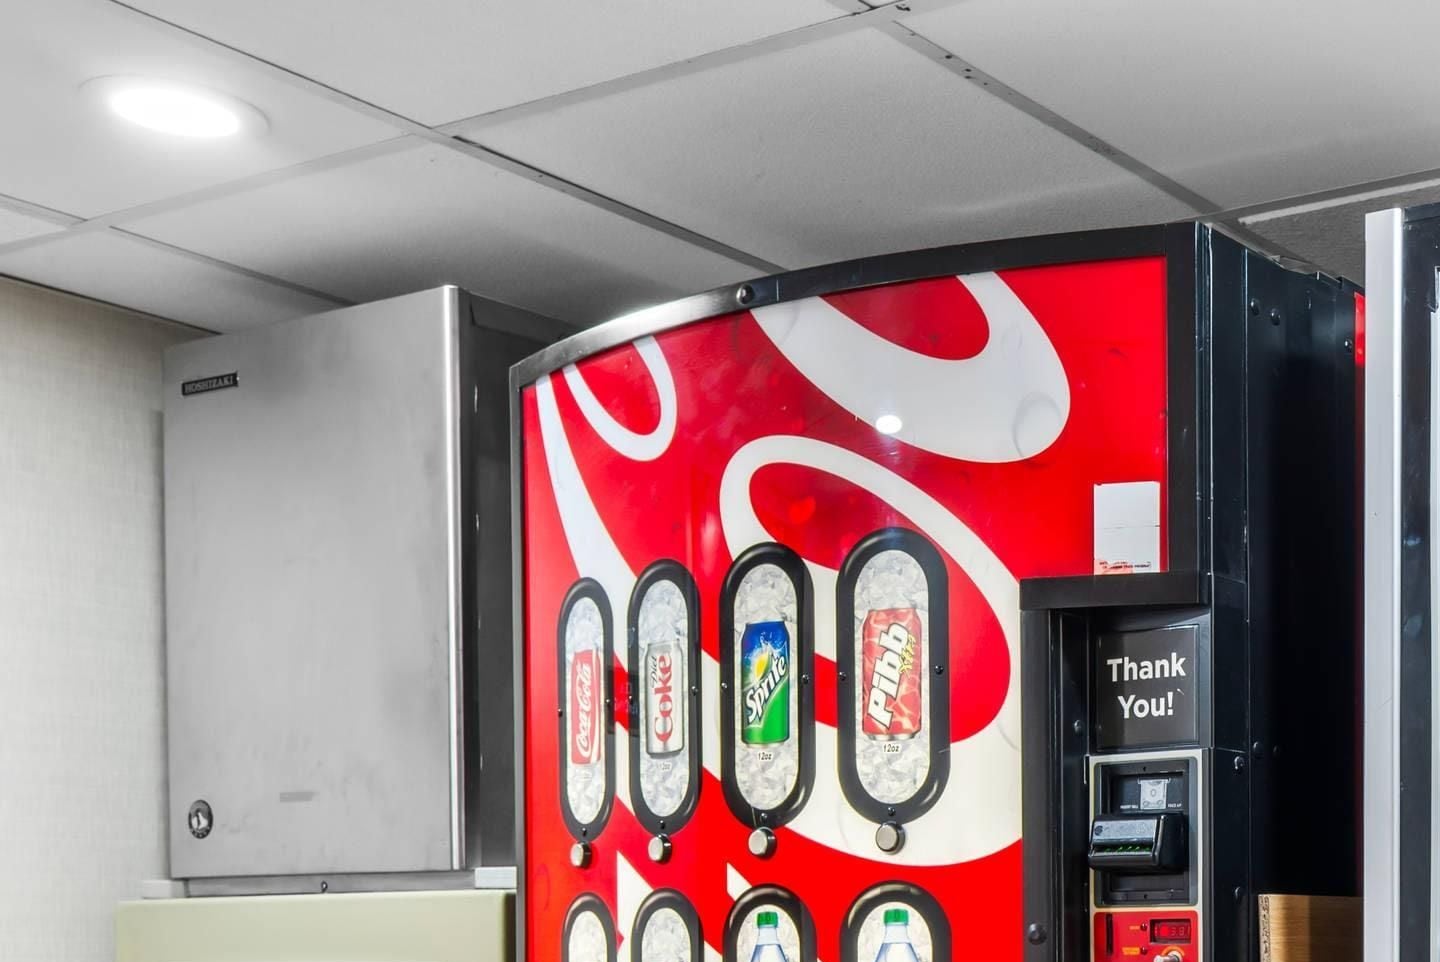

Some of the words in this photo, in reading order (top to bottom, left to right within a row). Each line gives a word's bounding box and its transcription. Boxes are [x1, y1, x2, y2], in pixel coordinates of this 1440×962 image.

[654, 654, 674, 743] Coke
[745, 652, 788, 724] Sprite
[867, 622, 910, 730] Pibb
[1107, 652, 1187, 683] Thank
[1118, 691, 1175, 720] You!
